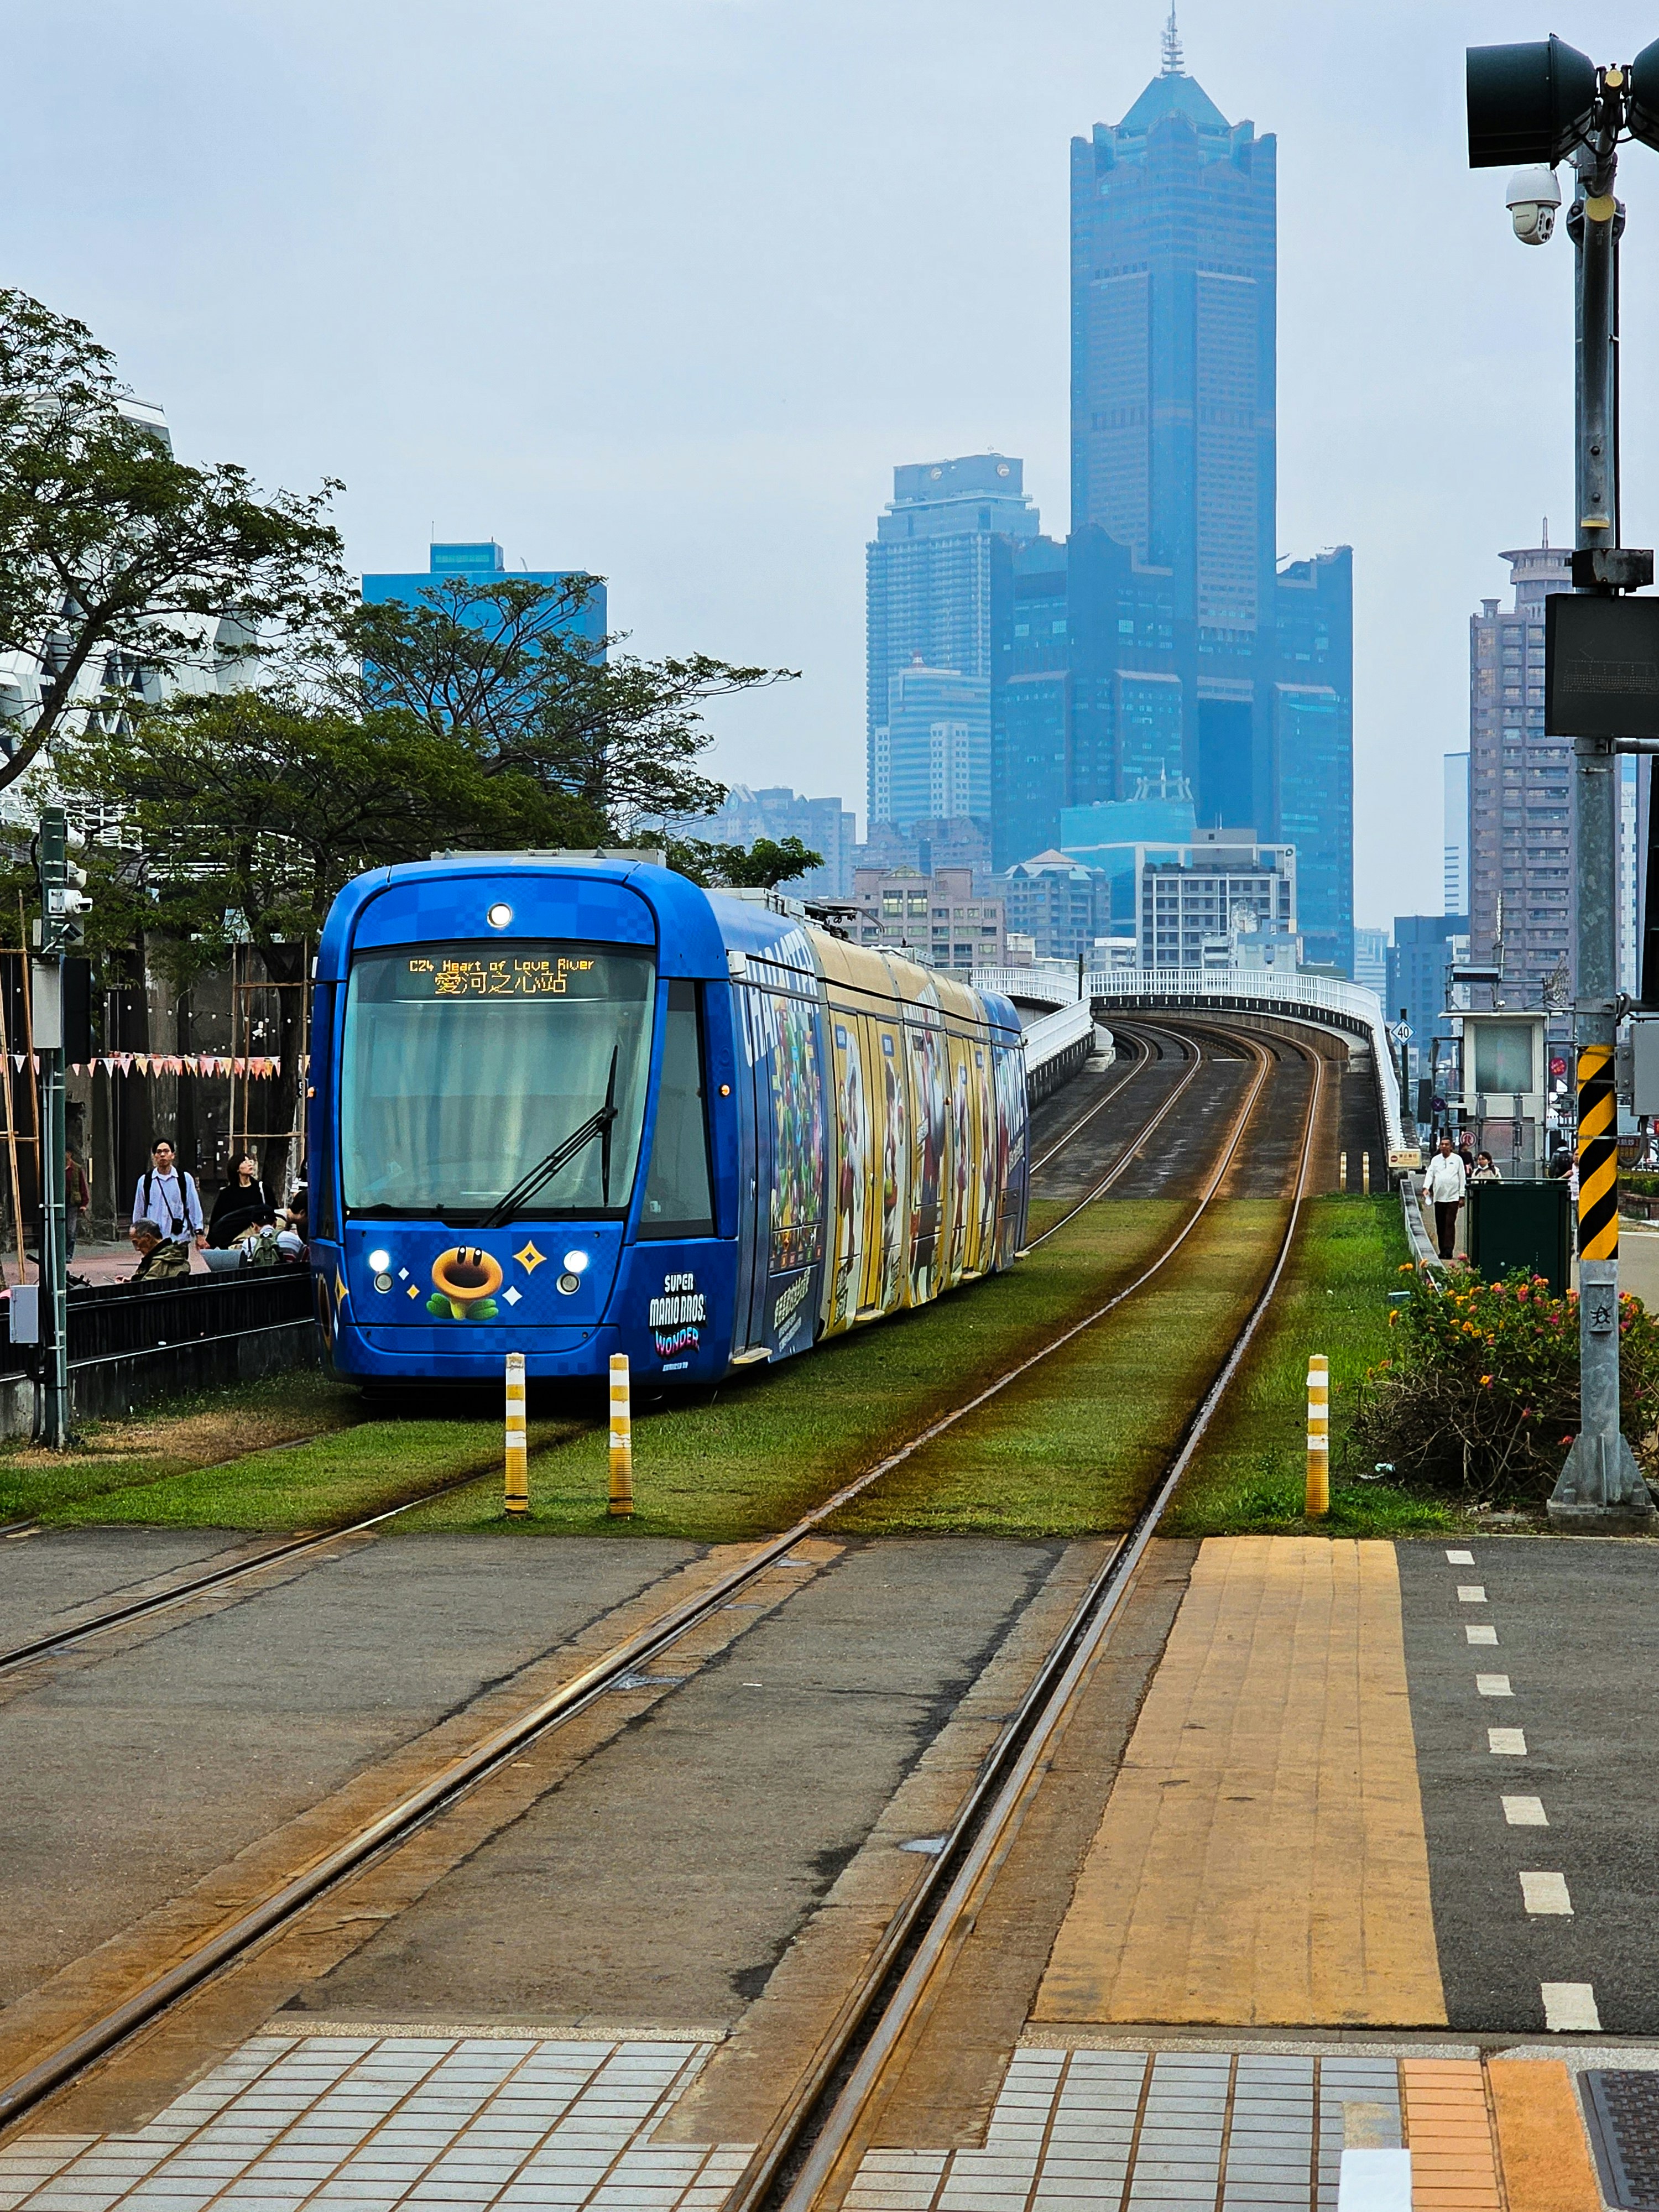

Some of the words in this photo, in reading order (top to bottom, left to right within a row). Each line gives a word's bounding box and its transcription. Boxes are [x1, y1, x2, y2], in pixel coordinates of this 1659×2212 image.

[410, 959, 434, 972] C24
[443, 959, 481, 972] Heart
[490, 961, 506, 971] of
[515, 959, 549, 971] Love
[558, 958, 594, 970] River
[435, 971, 566, 994] 愛河之心站
[1397, 1026, 1409, 1038] 40
[665, 1273, 693, 1293] SUPER
[649, 1296, 680, 1327] MARIO
[680, 1293, 706, 1323] BROS.
[655, 1327, 698, 1355] WONDER
